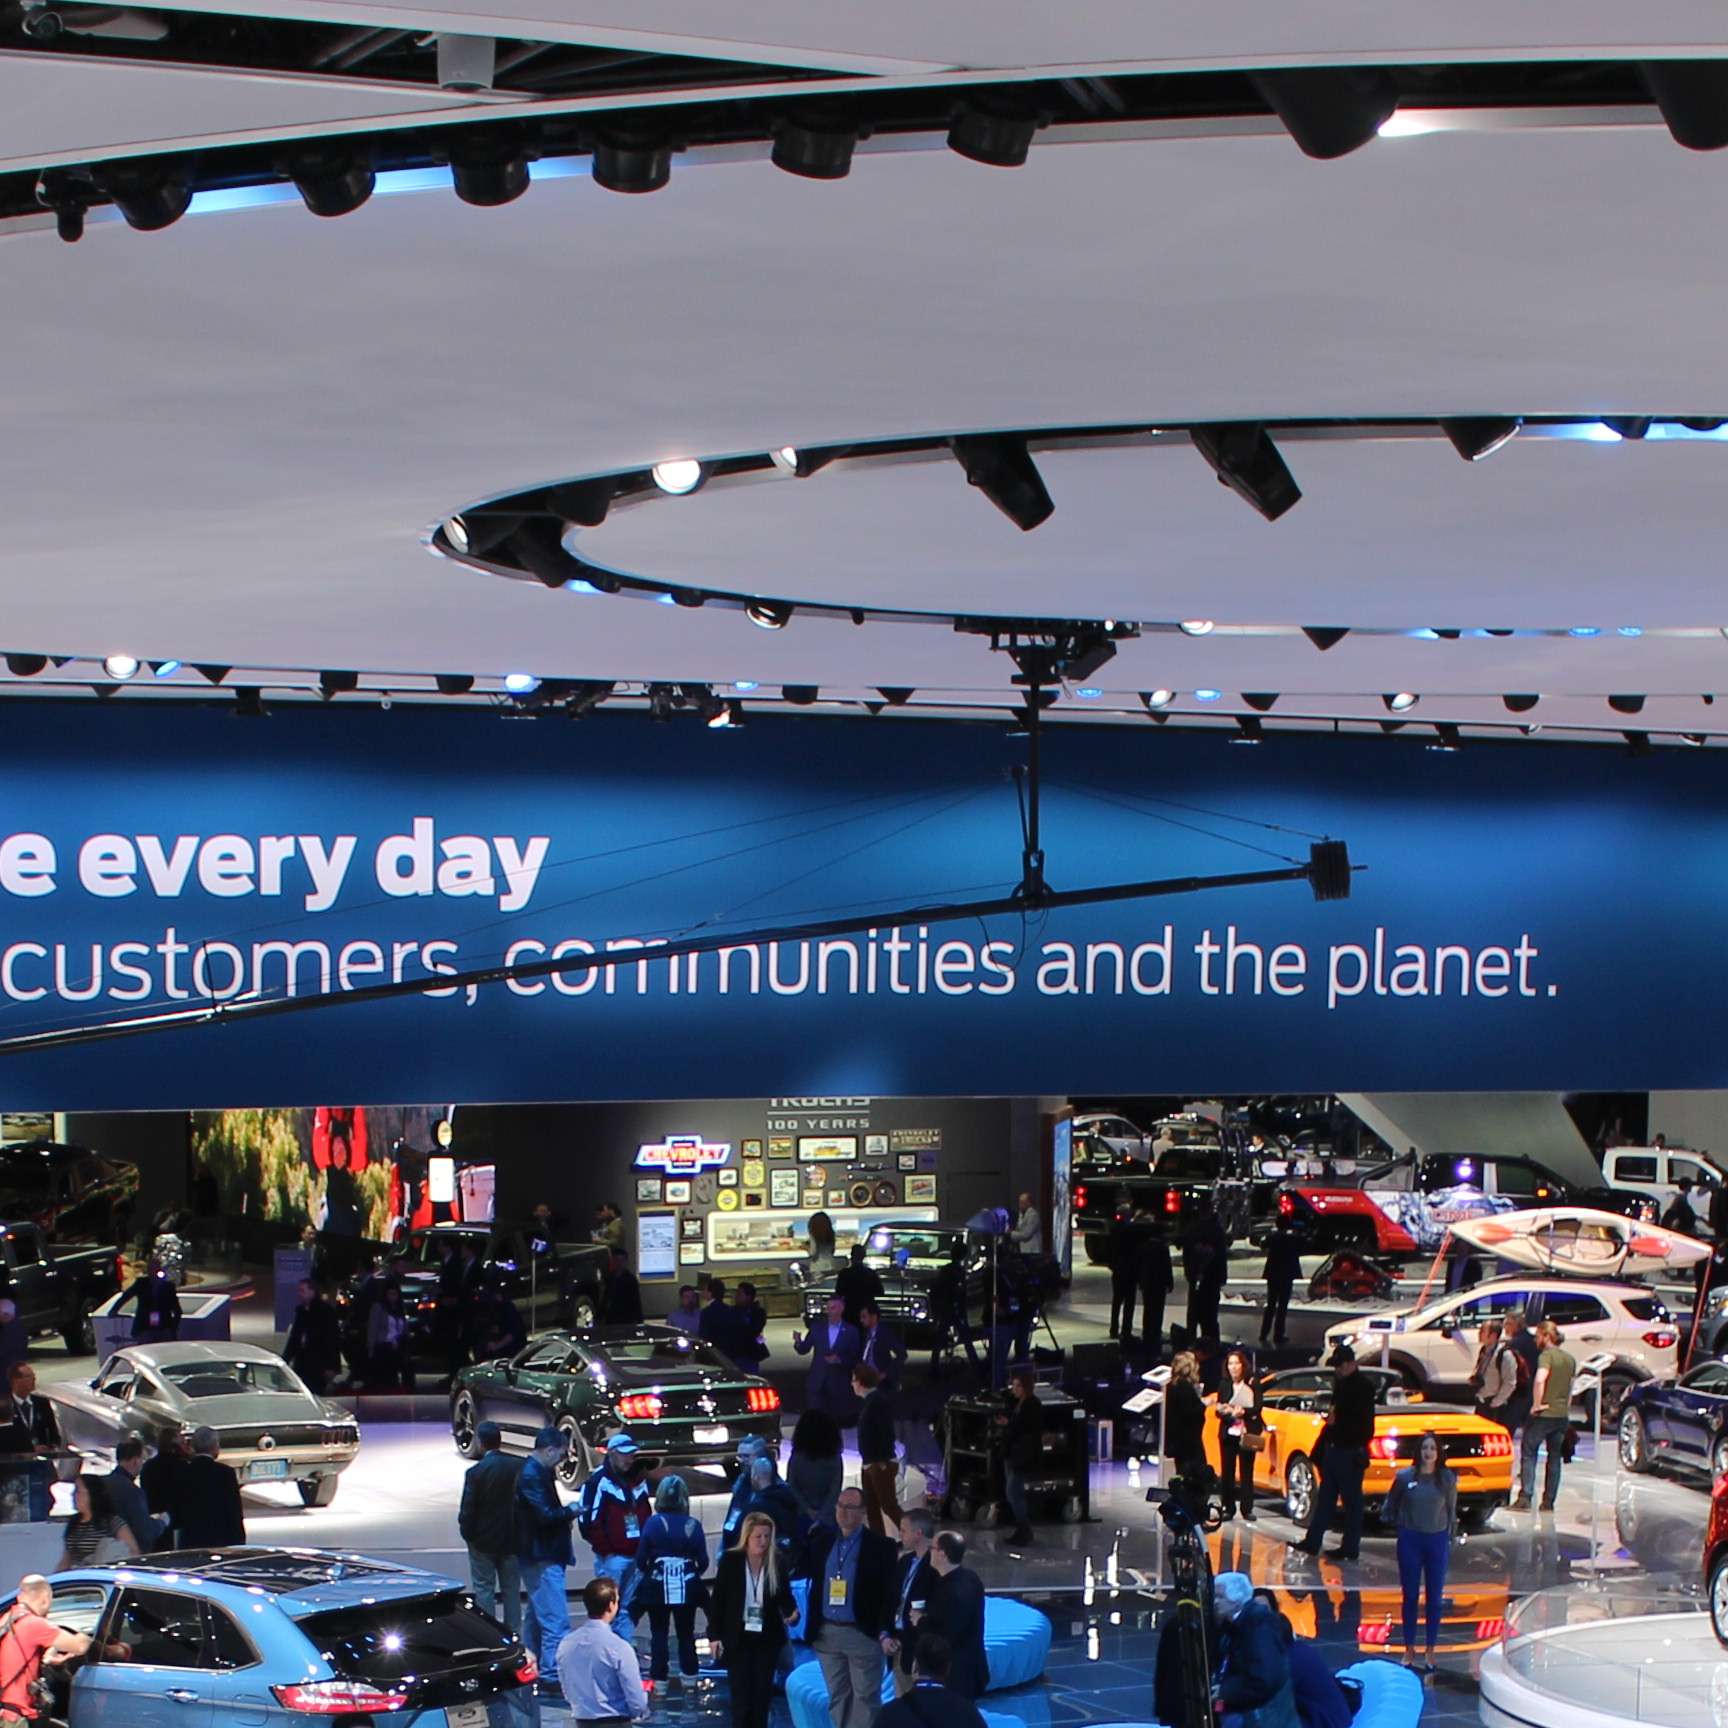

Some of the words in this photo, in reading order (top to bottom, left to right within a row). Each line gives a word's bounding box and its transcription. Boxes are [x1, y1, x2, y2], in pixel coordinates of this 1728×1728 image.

[79, 833, 356, 911] every
[376, 817, 549, 911] day
[2, 927, 477, 1006] customers,
[505, 926, 1014, 995] communities
[1037, 925, 1172, 994] and
[1195, 926, 1305, 995] the
[1329, 928, 1556, 1008] planet.
[767, 1119, 798, 1130] 100
[807, 1118, 869, 1129] YEARS
[644, 1146, 723, 1162] CHEVROLET
